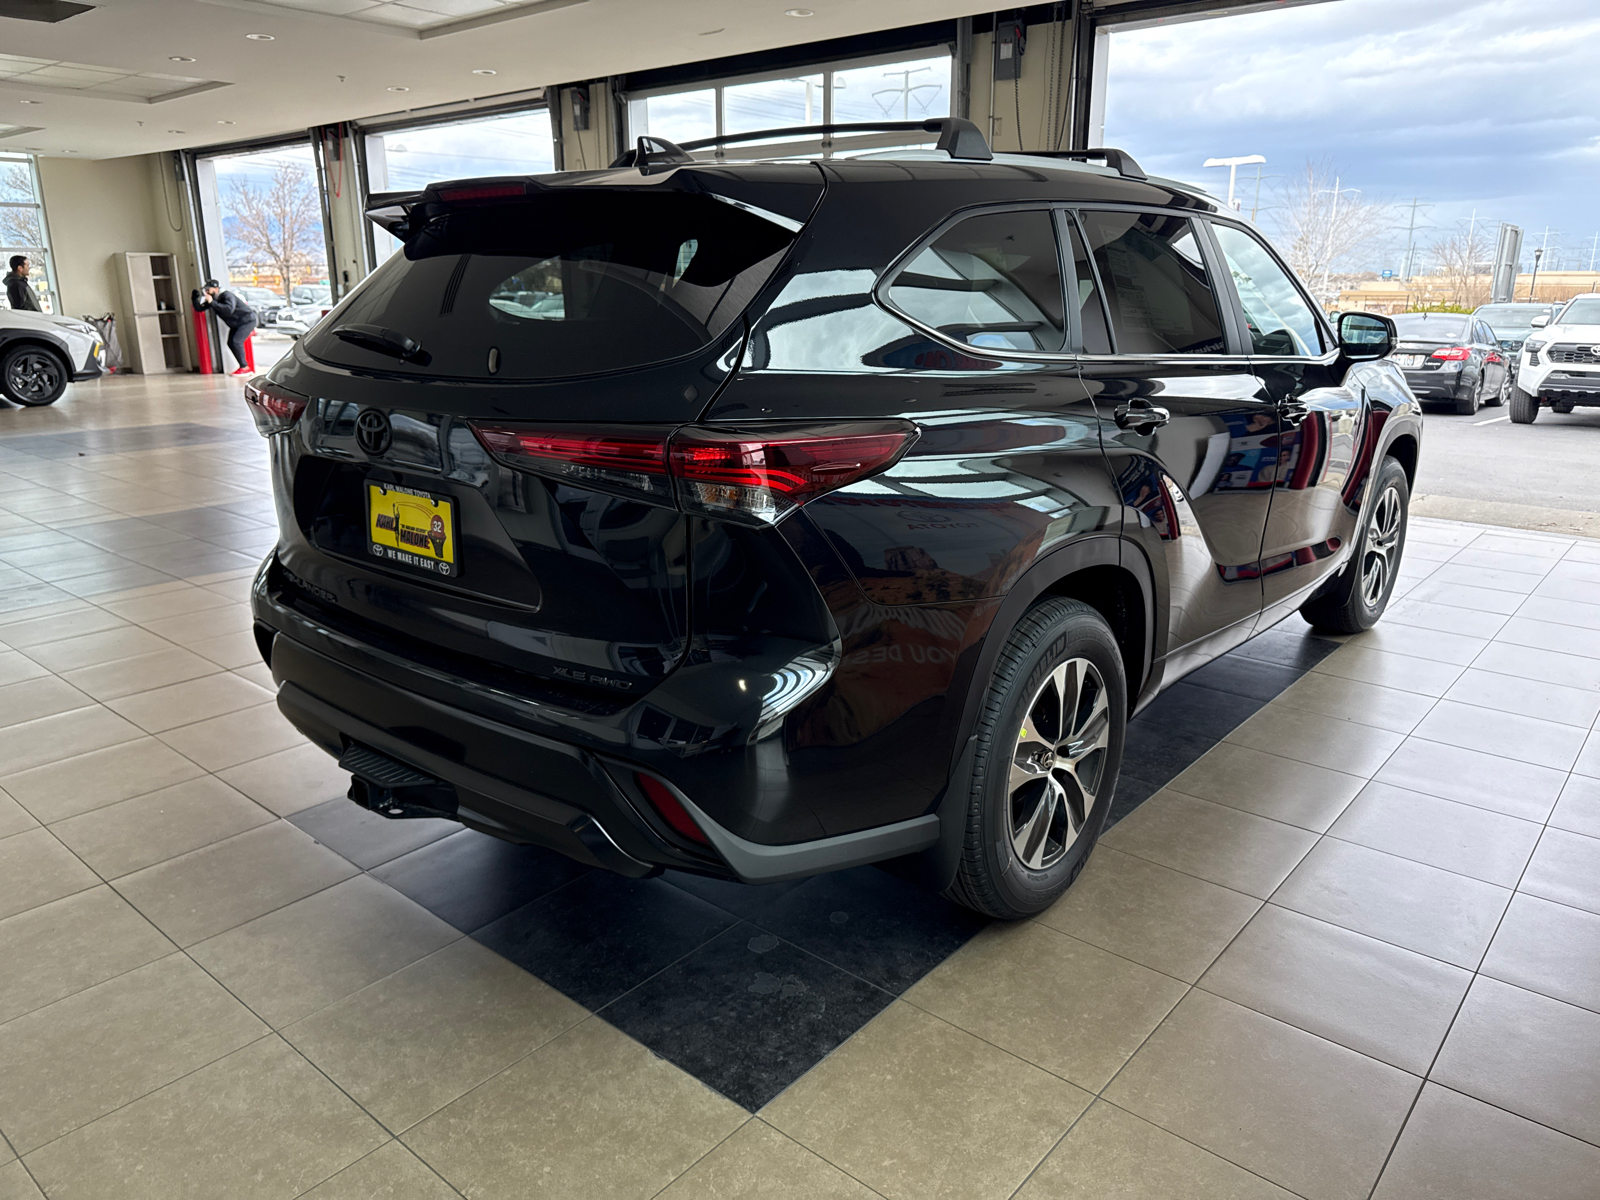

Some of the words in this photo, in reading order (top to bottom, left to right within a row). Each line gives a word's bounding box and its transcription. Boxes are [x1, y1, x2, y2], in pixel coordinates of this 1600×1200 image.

[376, 513, 396, 532] KARL
[433, 520, 442, 533] 32
[400, 528, 430, 549] MALONE
[387, 549, 396, 559] WE
[397, 551, 412, 564] MAKE
[413, 556, 419, 565] IT
[420, 558, 434, 570] EASY
[552, 664, 588, 682] XLE
[590, 673, 633, 690] AWD
[1014, 634, 1066, 718] MICHELIN
